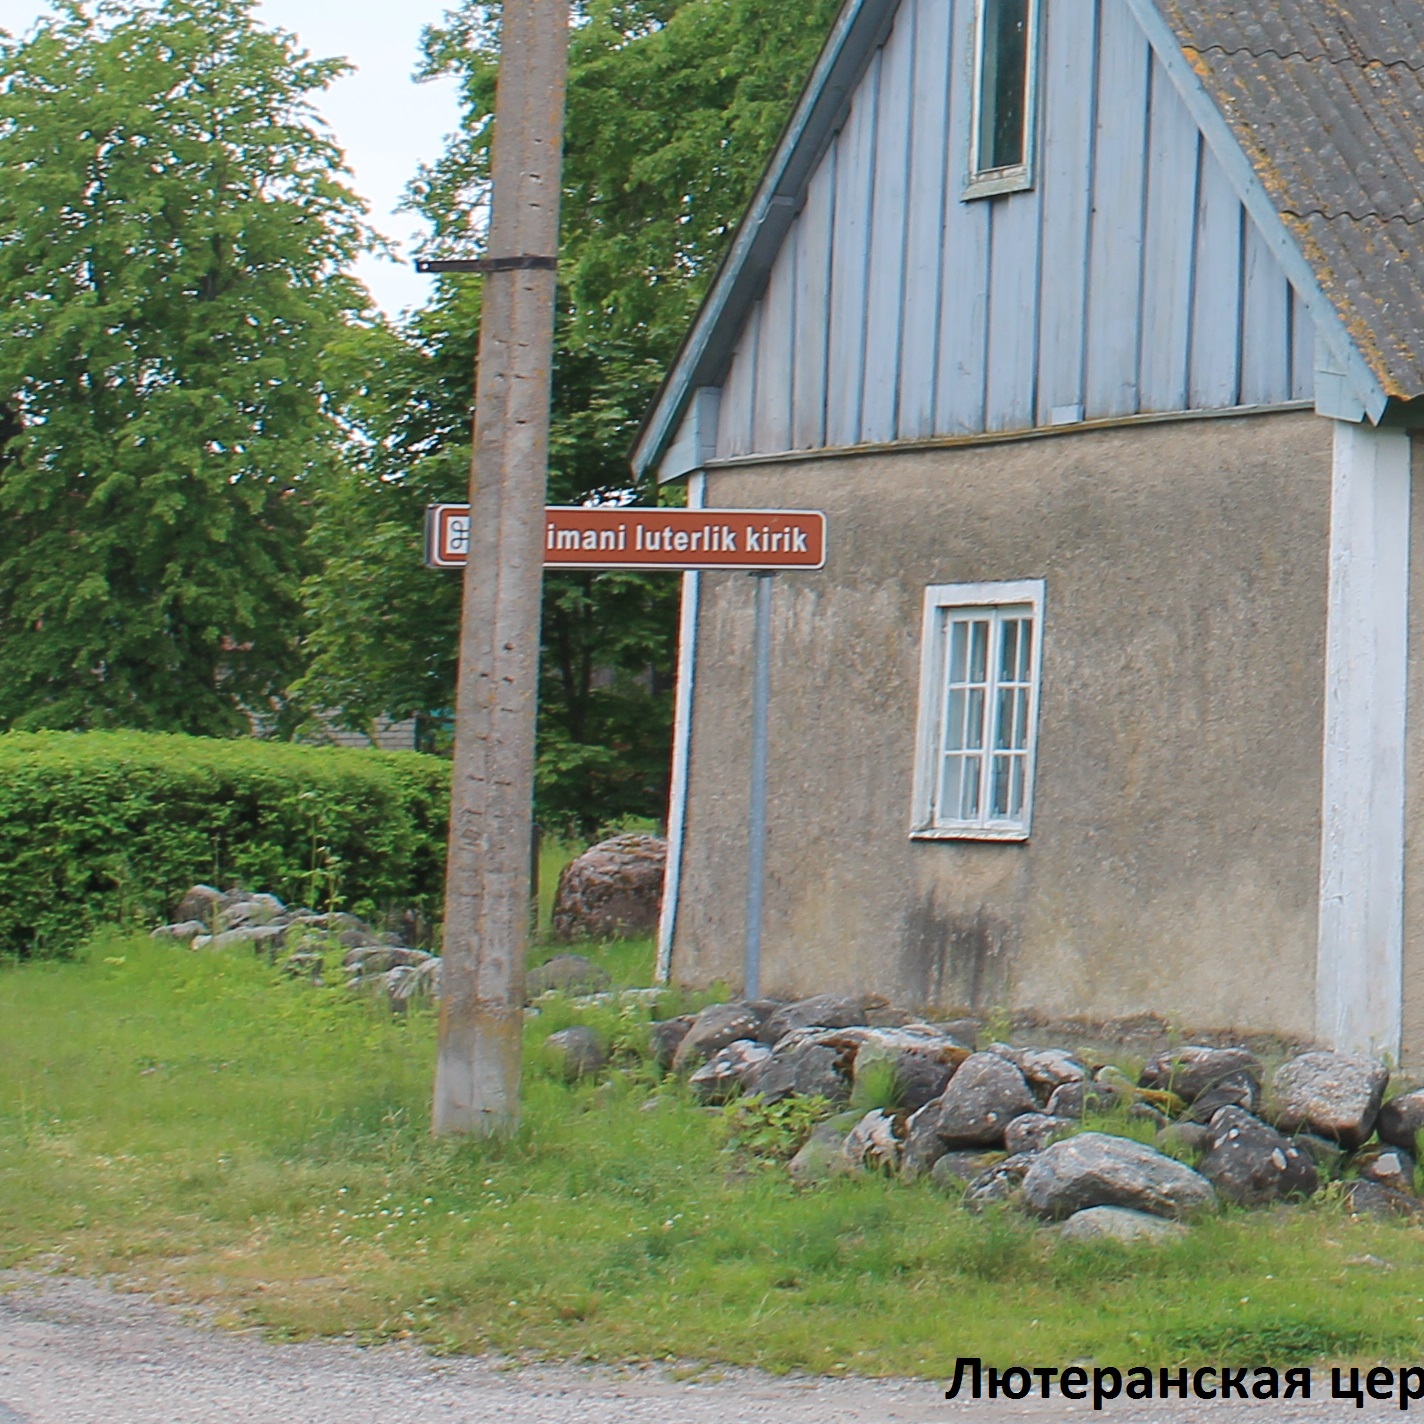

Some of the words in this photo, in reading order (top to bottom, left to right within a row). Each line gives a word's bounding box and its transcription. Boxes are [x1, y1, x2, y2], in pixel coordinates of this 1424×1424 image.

[546, 523, 627, 551] imani
[635, 524, 738, 552] luterlik
[745, 526, 808, 553] kirik
